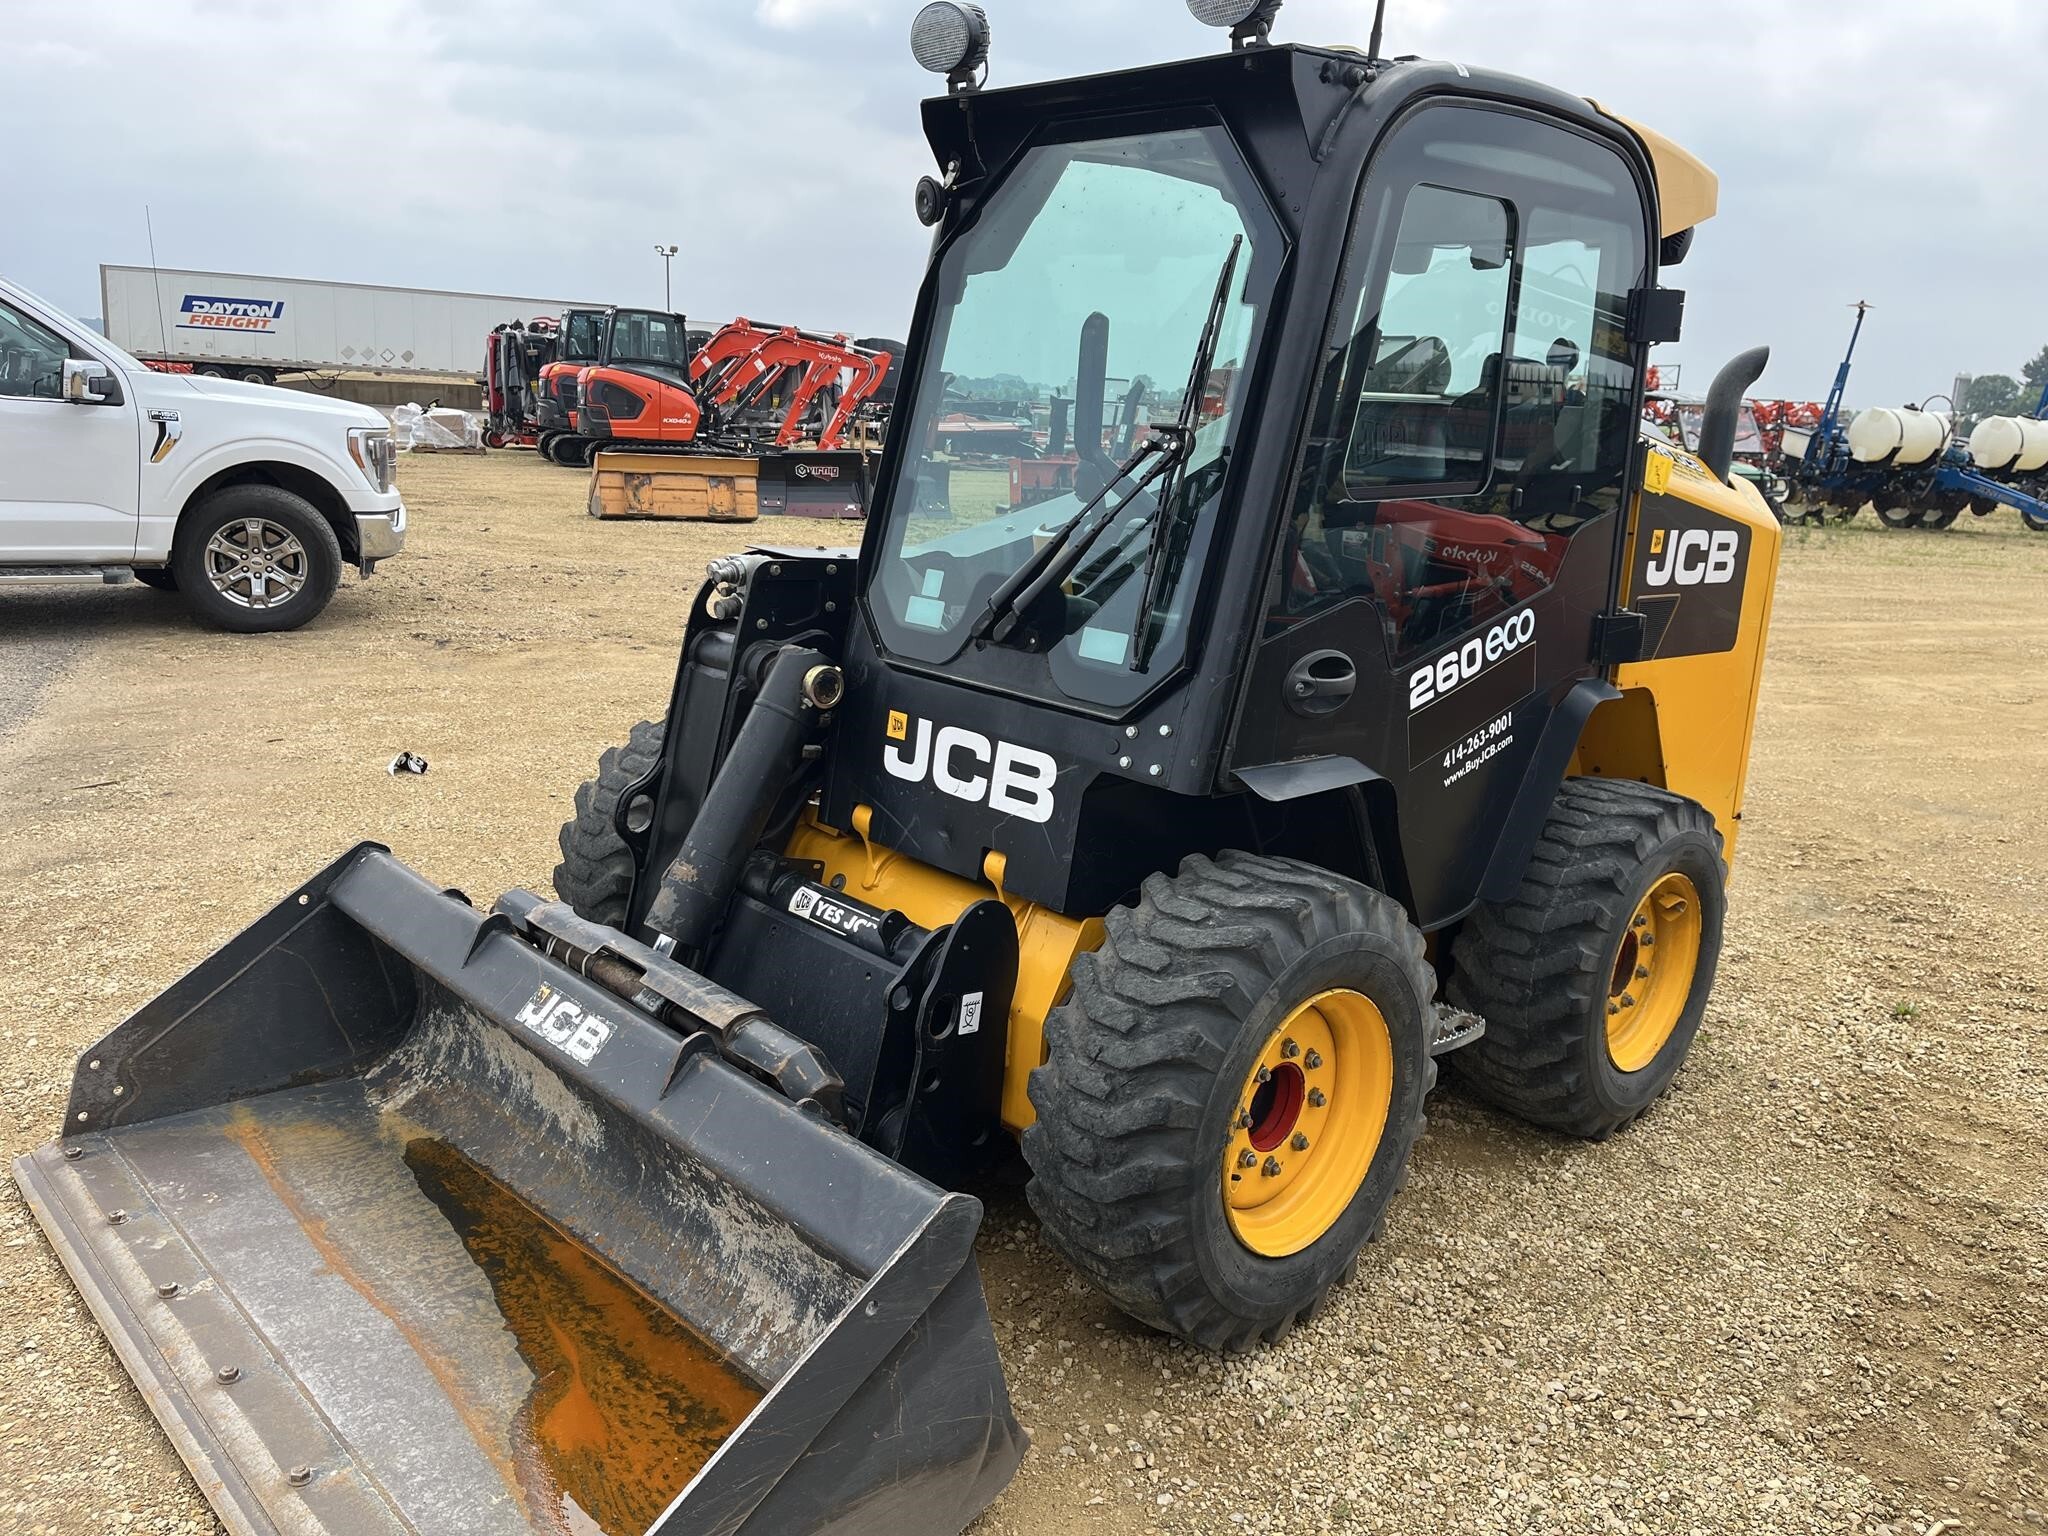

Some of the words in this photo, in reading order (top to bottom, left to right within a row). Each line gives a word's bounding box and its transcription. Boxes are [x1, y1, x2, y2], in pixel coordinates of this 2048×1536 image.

[189, 314, 271, 329] FREIGHT
[192, 300, 276, 318] DAYTON
[818, 351, 842, 363] Kubota
[1646, 529, 1739, 587] JCB
[1442, 711, 1512, 769] 414-263-9001
[1443, 734, 1513, 787] www.BuyJCB.com
[883, 717, 1058, 824] JCB
[796, 892, 812, 909] JCB
[815, 900, 845, 924] YES
[517, 992, 611, 1063] JCB
